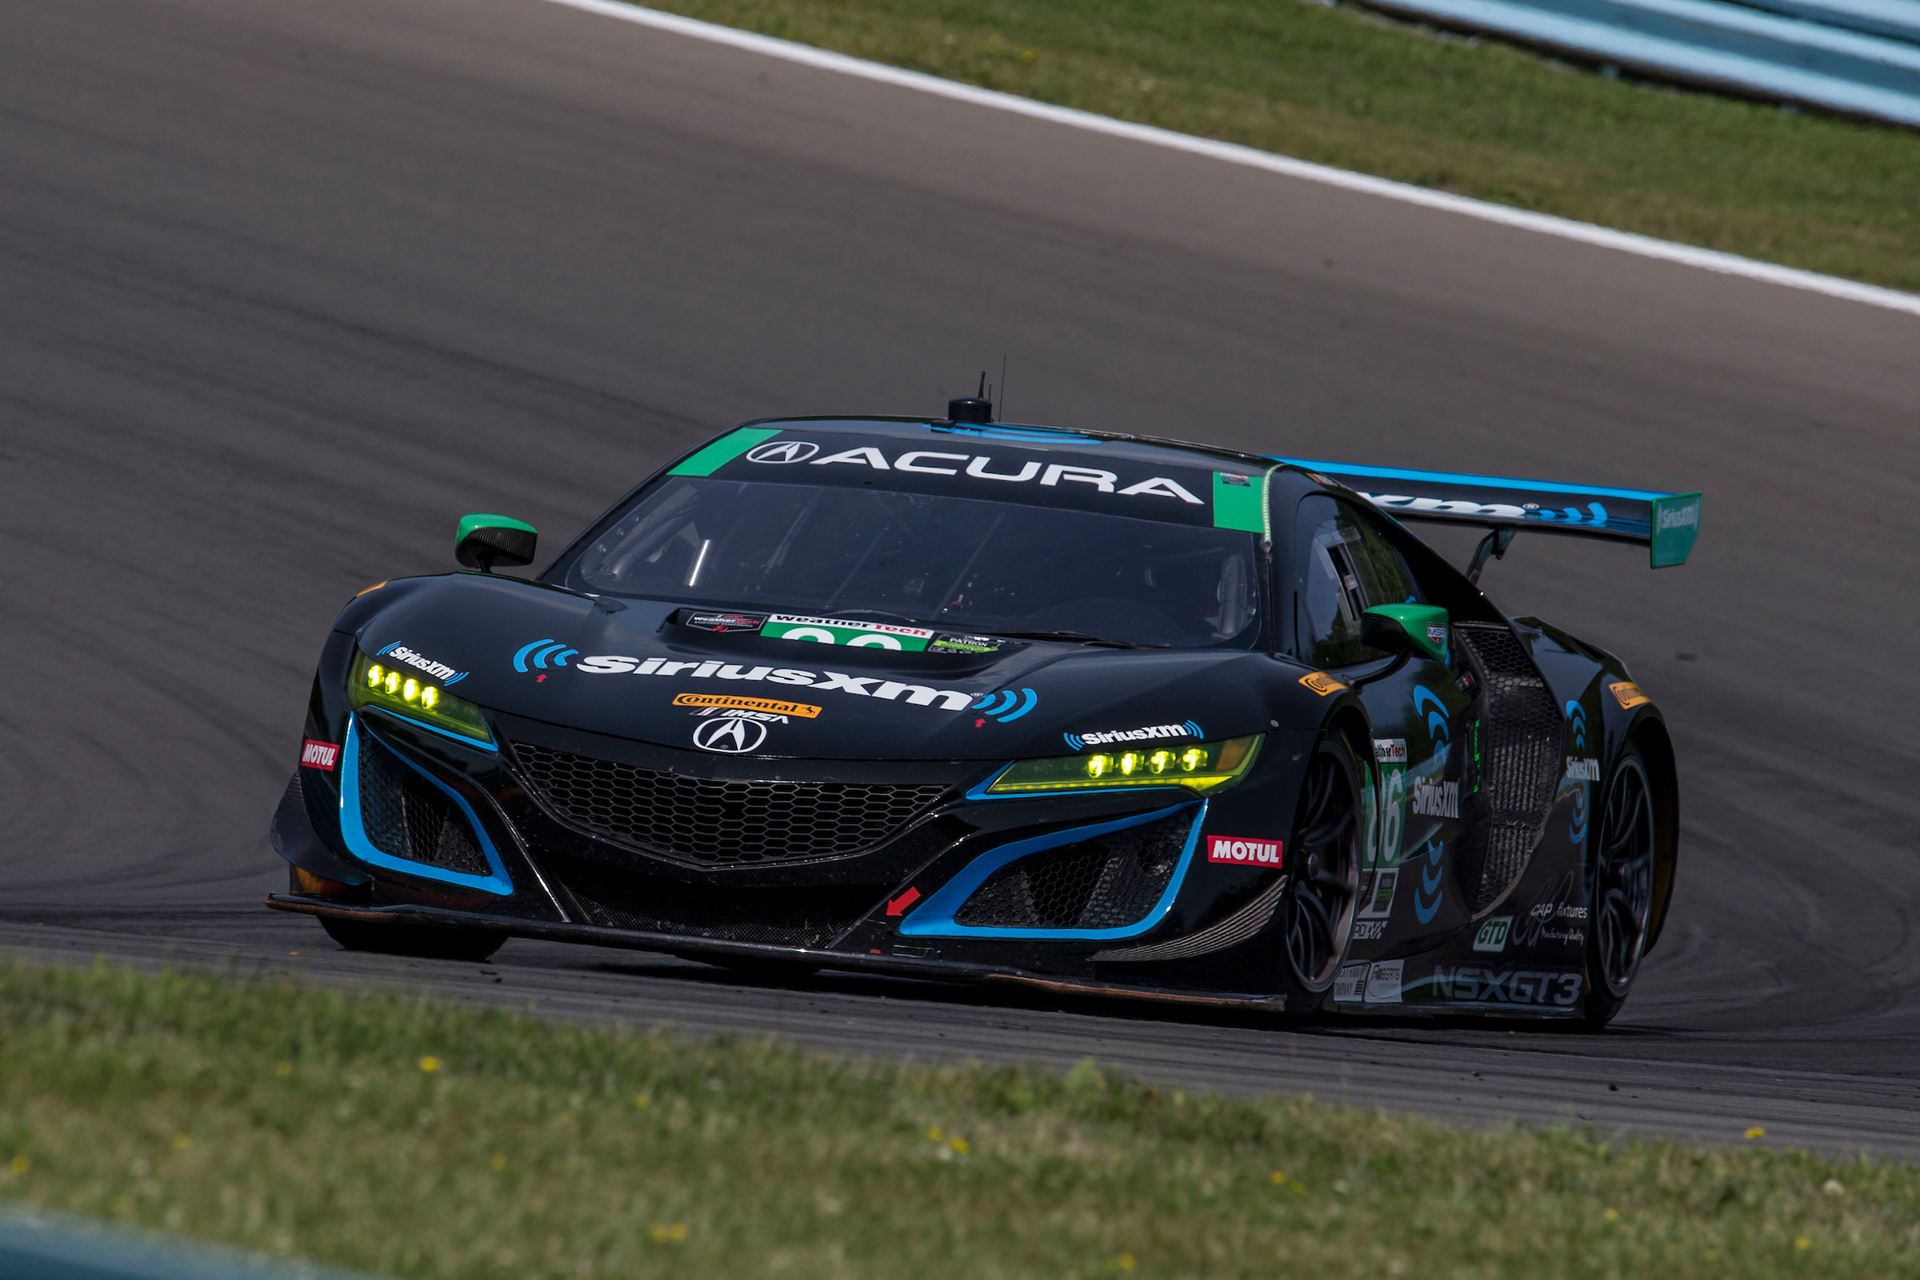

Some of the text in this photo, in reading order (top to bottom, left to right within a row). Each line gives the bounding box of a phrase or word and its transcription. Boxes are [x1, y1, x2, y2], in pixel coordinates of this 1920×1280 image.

[809, 447, 1206, 505] ACURA
[677, 694, 799, 713] Continental
[721, 708, 790, 725] IMSA
[302, 743, 336, 767] MOTUL
[1212, 840, 1280, 864] MOTUL
[1557, 901, 1588, 919] fixtures
[1478, 920, 1509, 945] GTD
